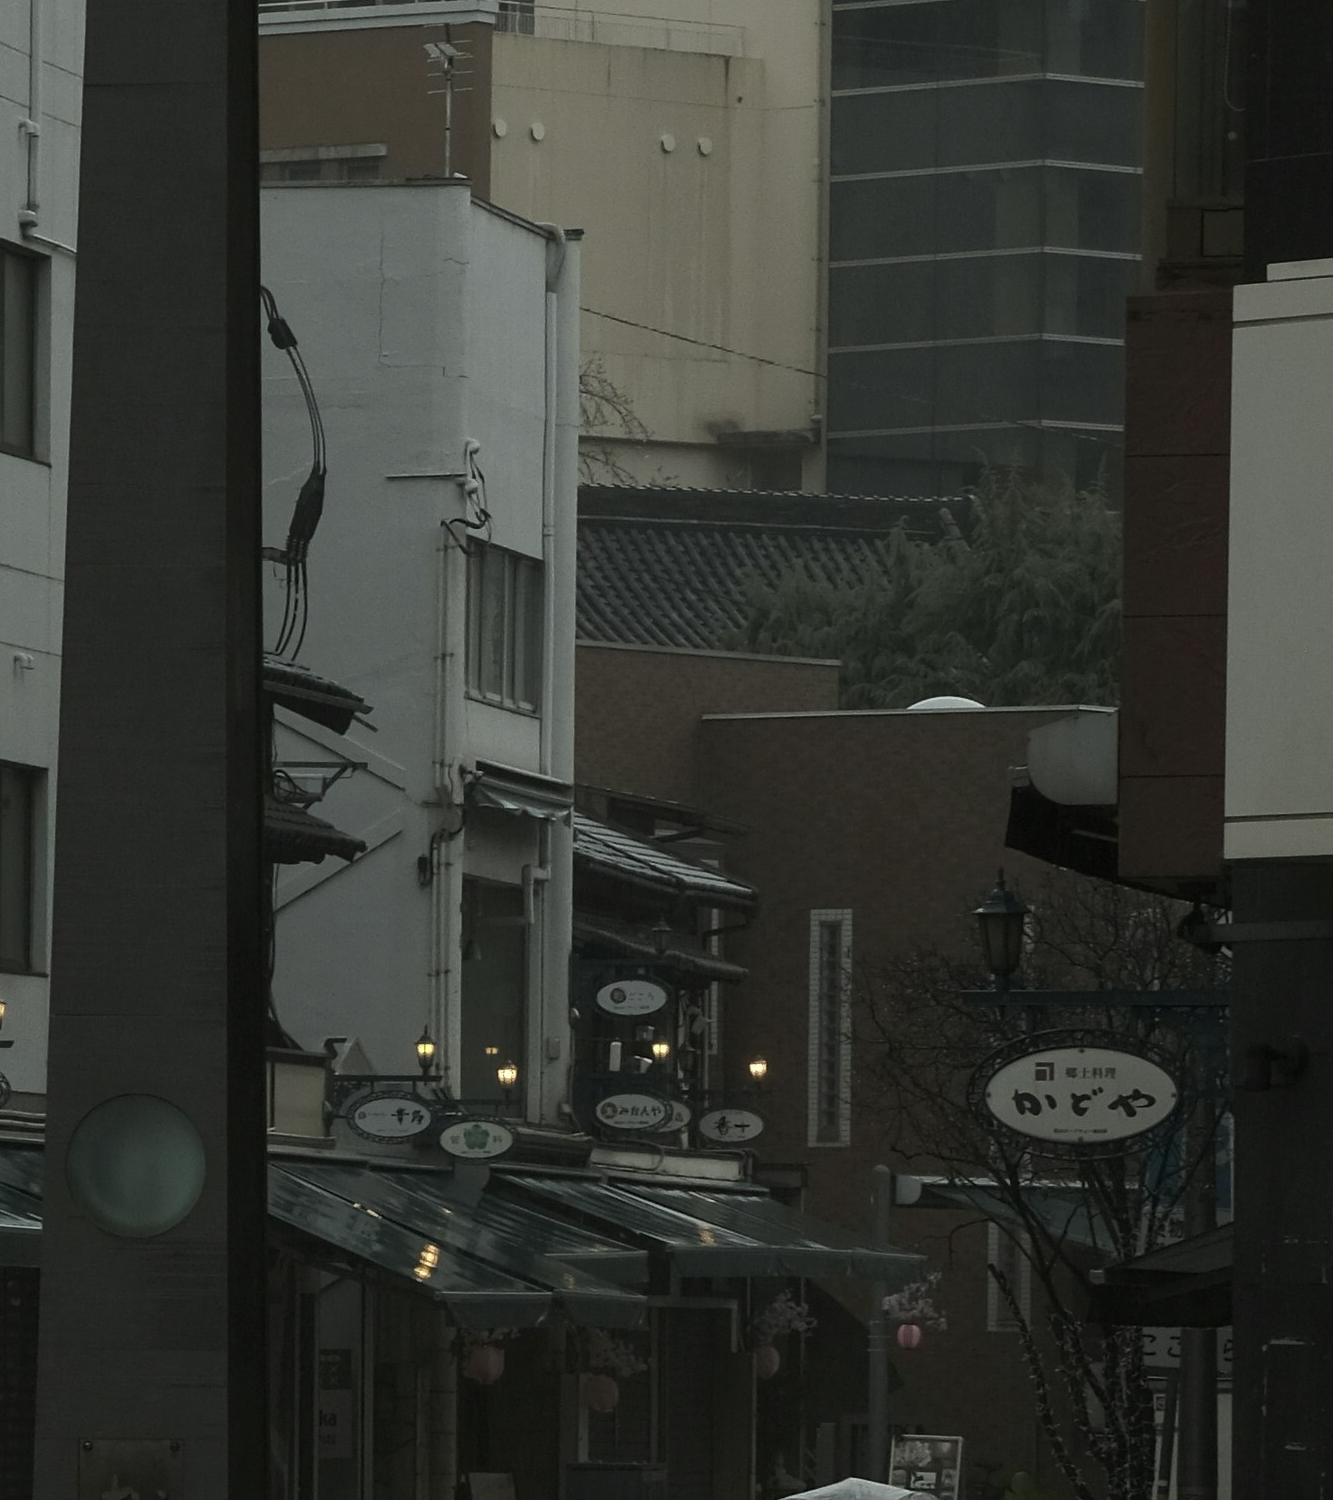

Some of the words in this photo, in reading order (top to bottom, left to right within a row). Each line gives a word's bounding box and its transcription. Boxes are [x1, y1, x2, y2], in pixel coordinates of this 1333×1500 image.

[1065, 1066, 1116, 1080] 郷土料理
[1012, 1087, 1156, 1117] かどや
